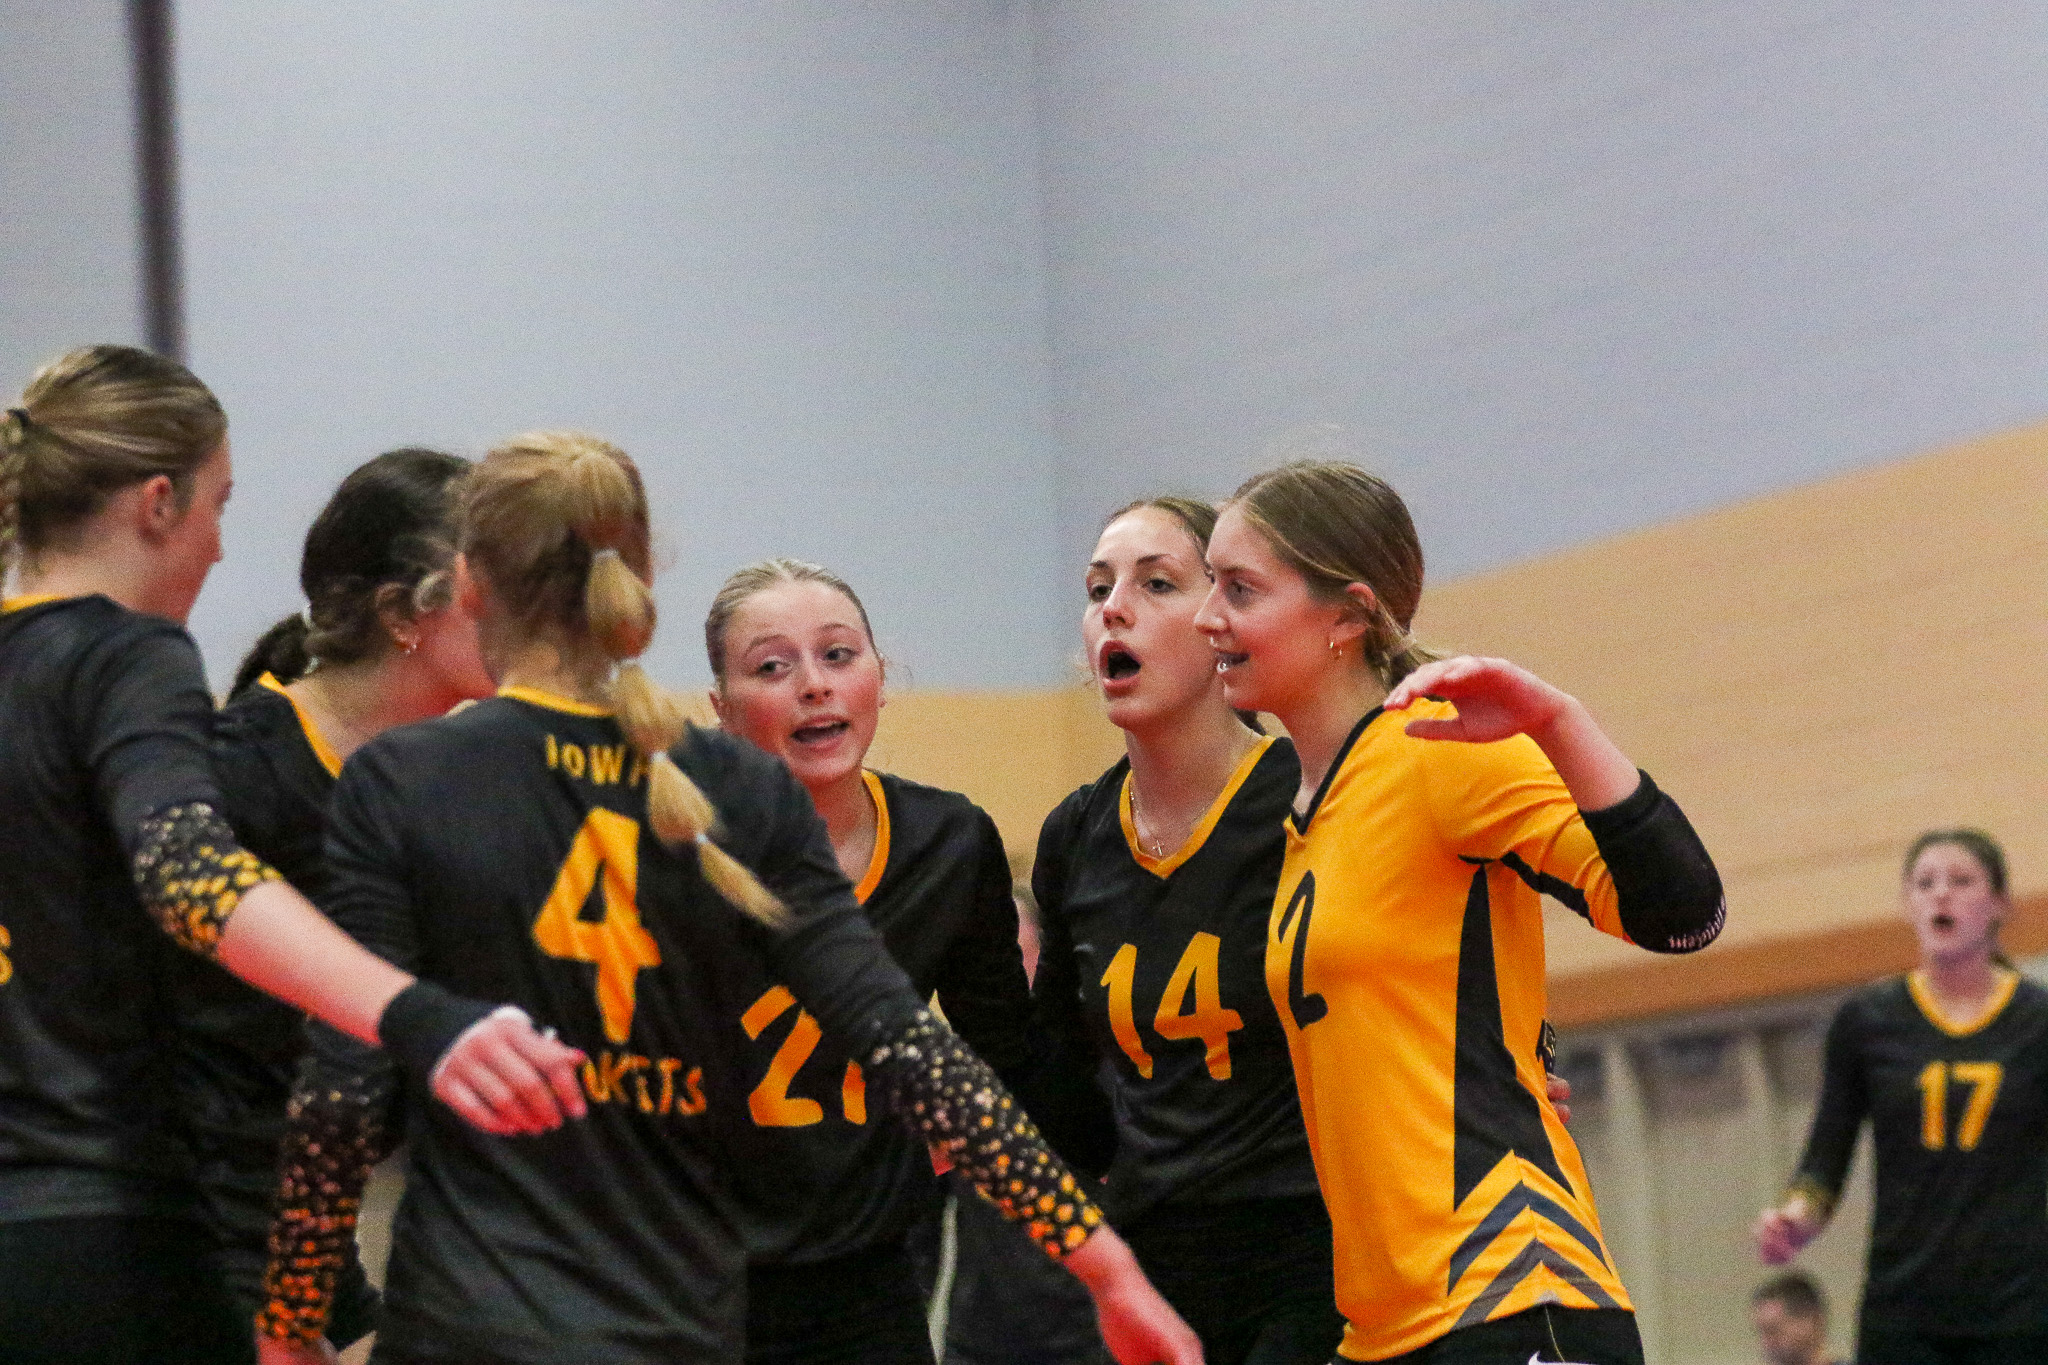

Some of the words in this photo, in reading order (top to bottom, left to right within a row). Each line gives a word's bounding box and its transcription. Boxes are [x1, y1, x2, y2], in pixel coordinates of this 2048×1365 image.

[532, 806, 662, 1045] 4
[1100, 931, 1245, 1080] 14
[1914, 1060, 2004, 1152] 17
